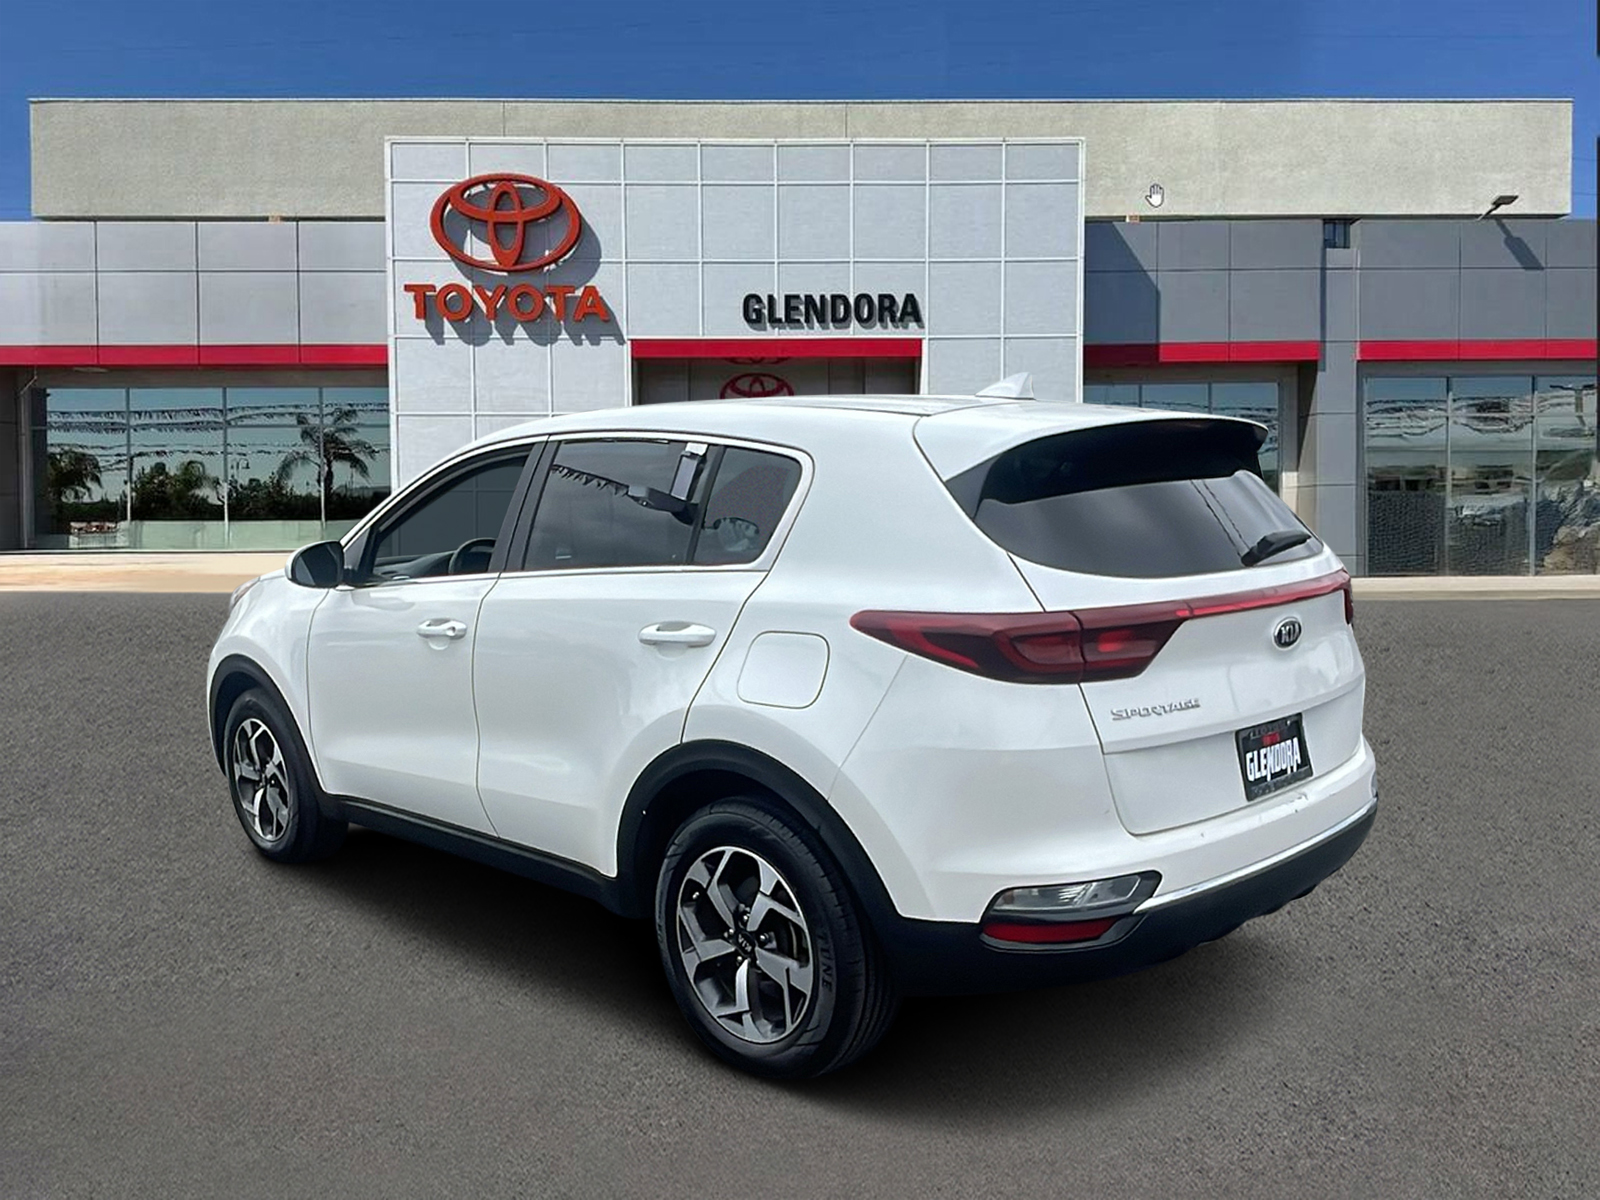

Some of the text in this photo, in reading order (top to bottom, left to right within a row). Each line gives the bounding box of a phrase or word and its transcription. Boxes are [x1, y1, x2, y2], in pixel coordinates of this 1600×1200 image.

[404, 283, 610, 323] TOYOTA
[742, 293, 924, 328] GLENDORA
[1245, 736, 1302, 782] GLENDORA
